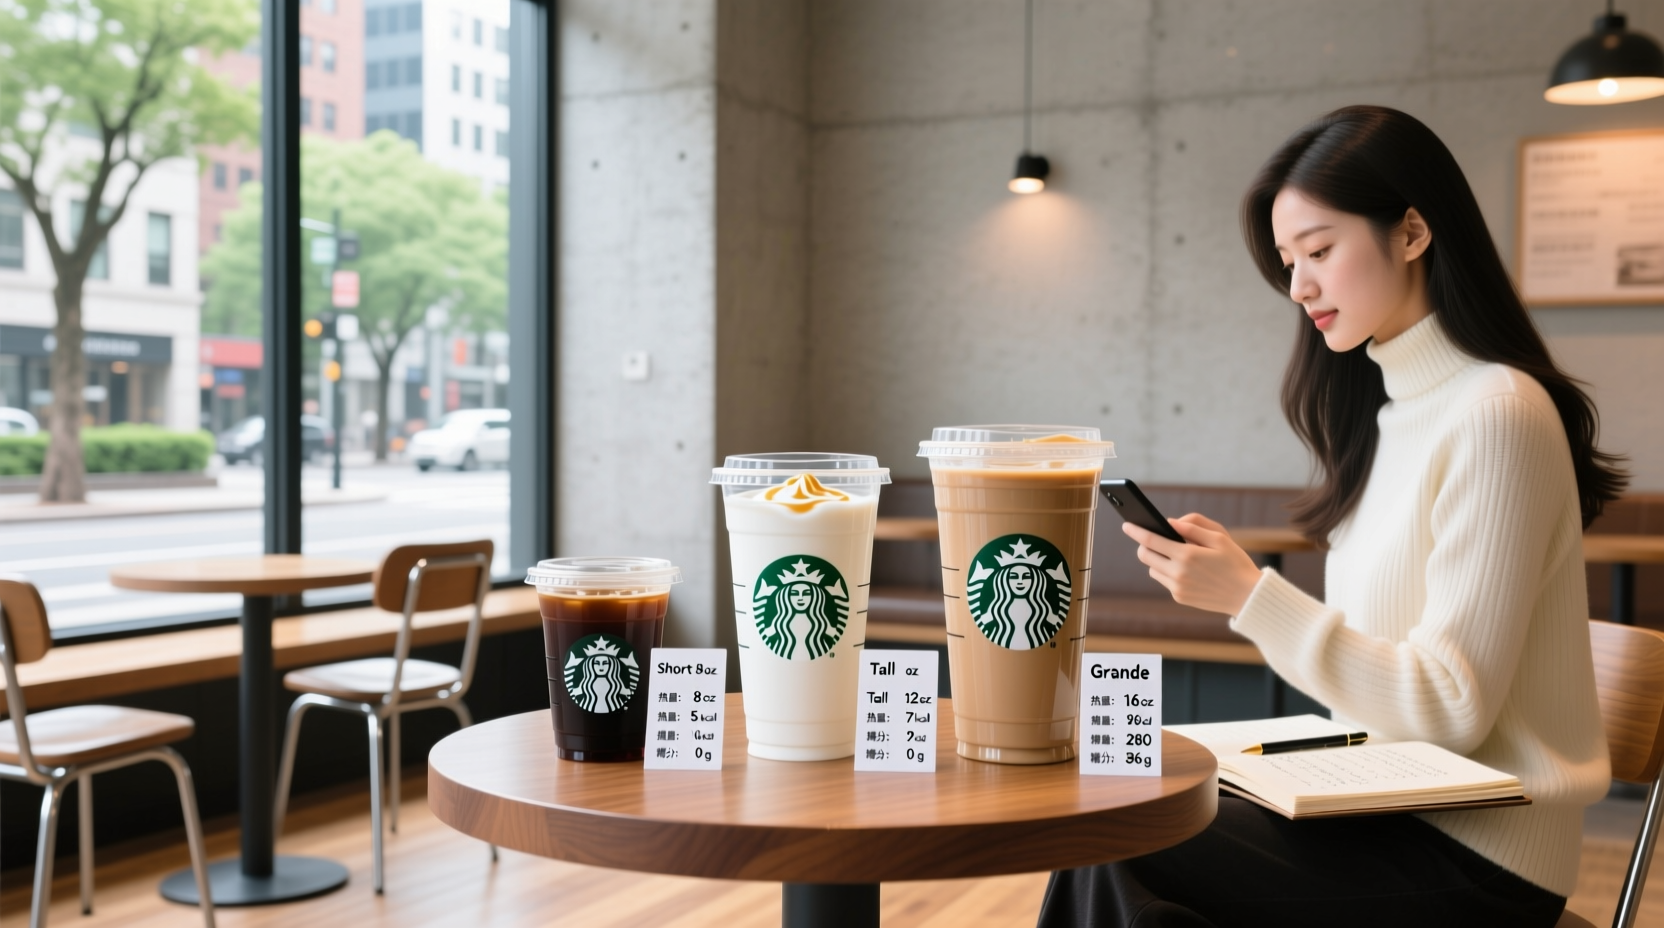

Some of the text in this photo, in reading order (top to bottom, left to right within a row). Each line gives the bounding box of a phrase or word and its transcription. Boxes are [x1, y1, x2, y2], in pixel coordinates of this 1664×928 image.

[657, 662, 692, 675] Short
[869, 661, 919, 676] Tall oz
[1090, 664, 1150, 680] Grande
[866, 691, 889, 704] Tall
